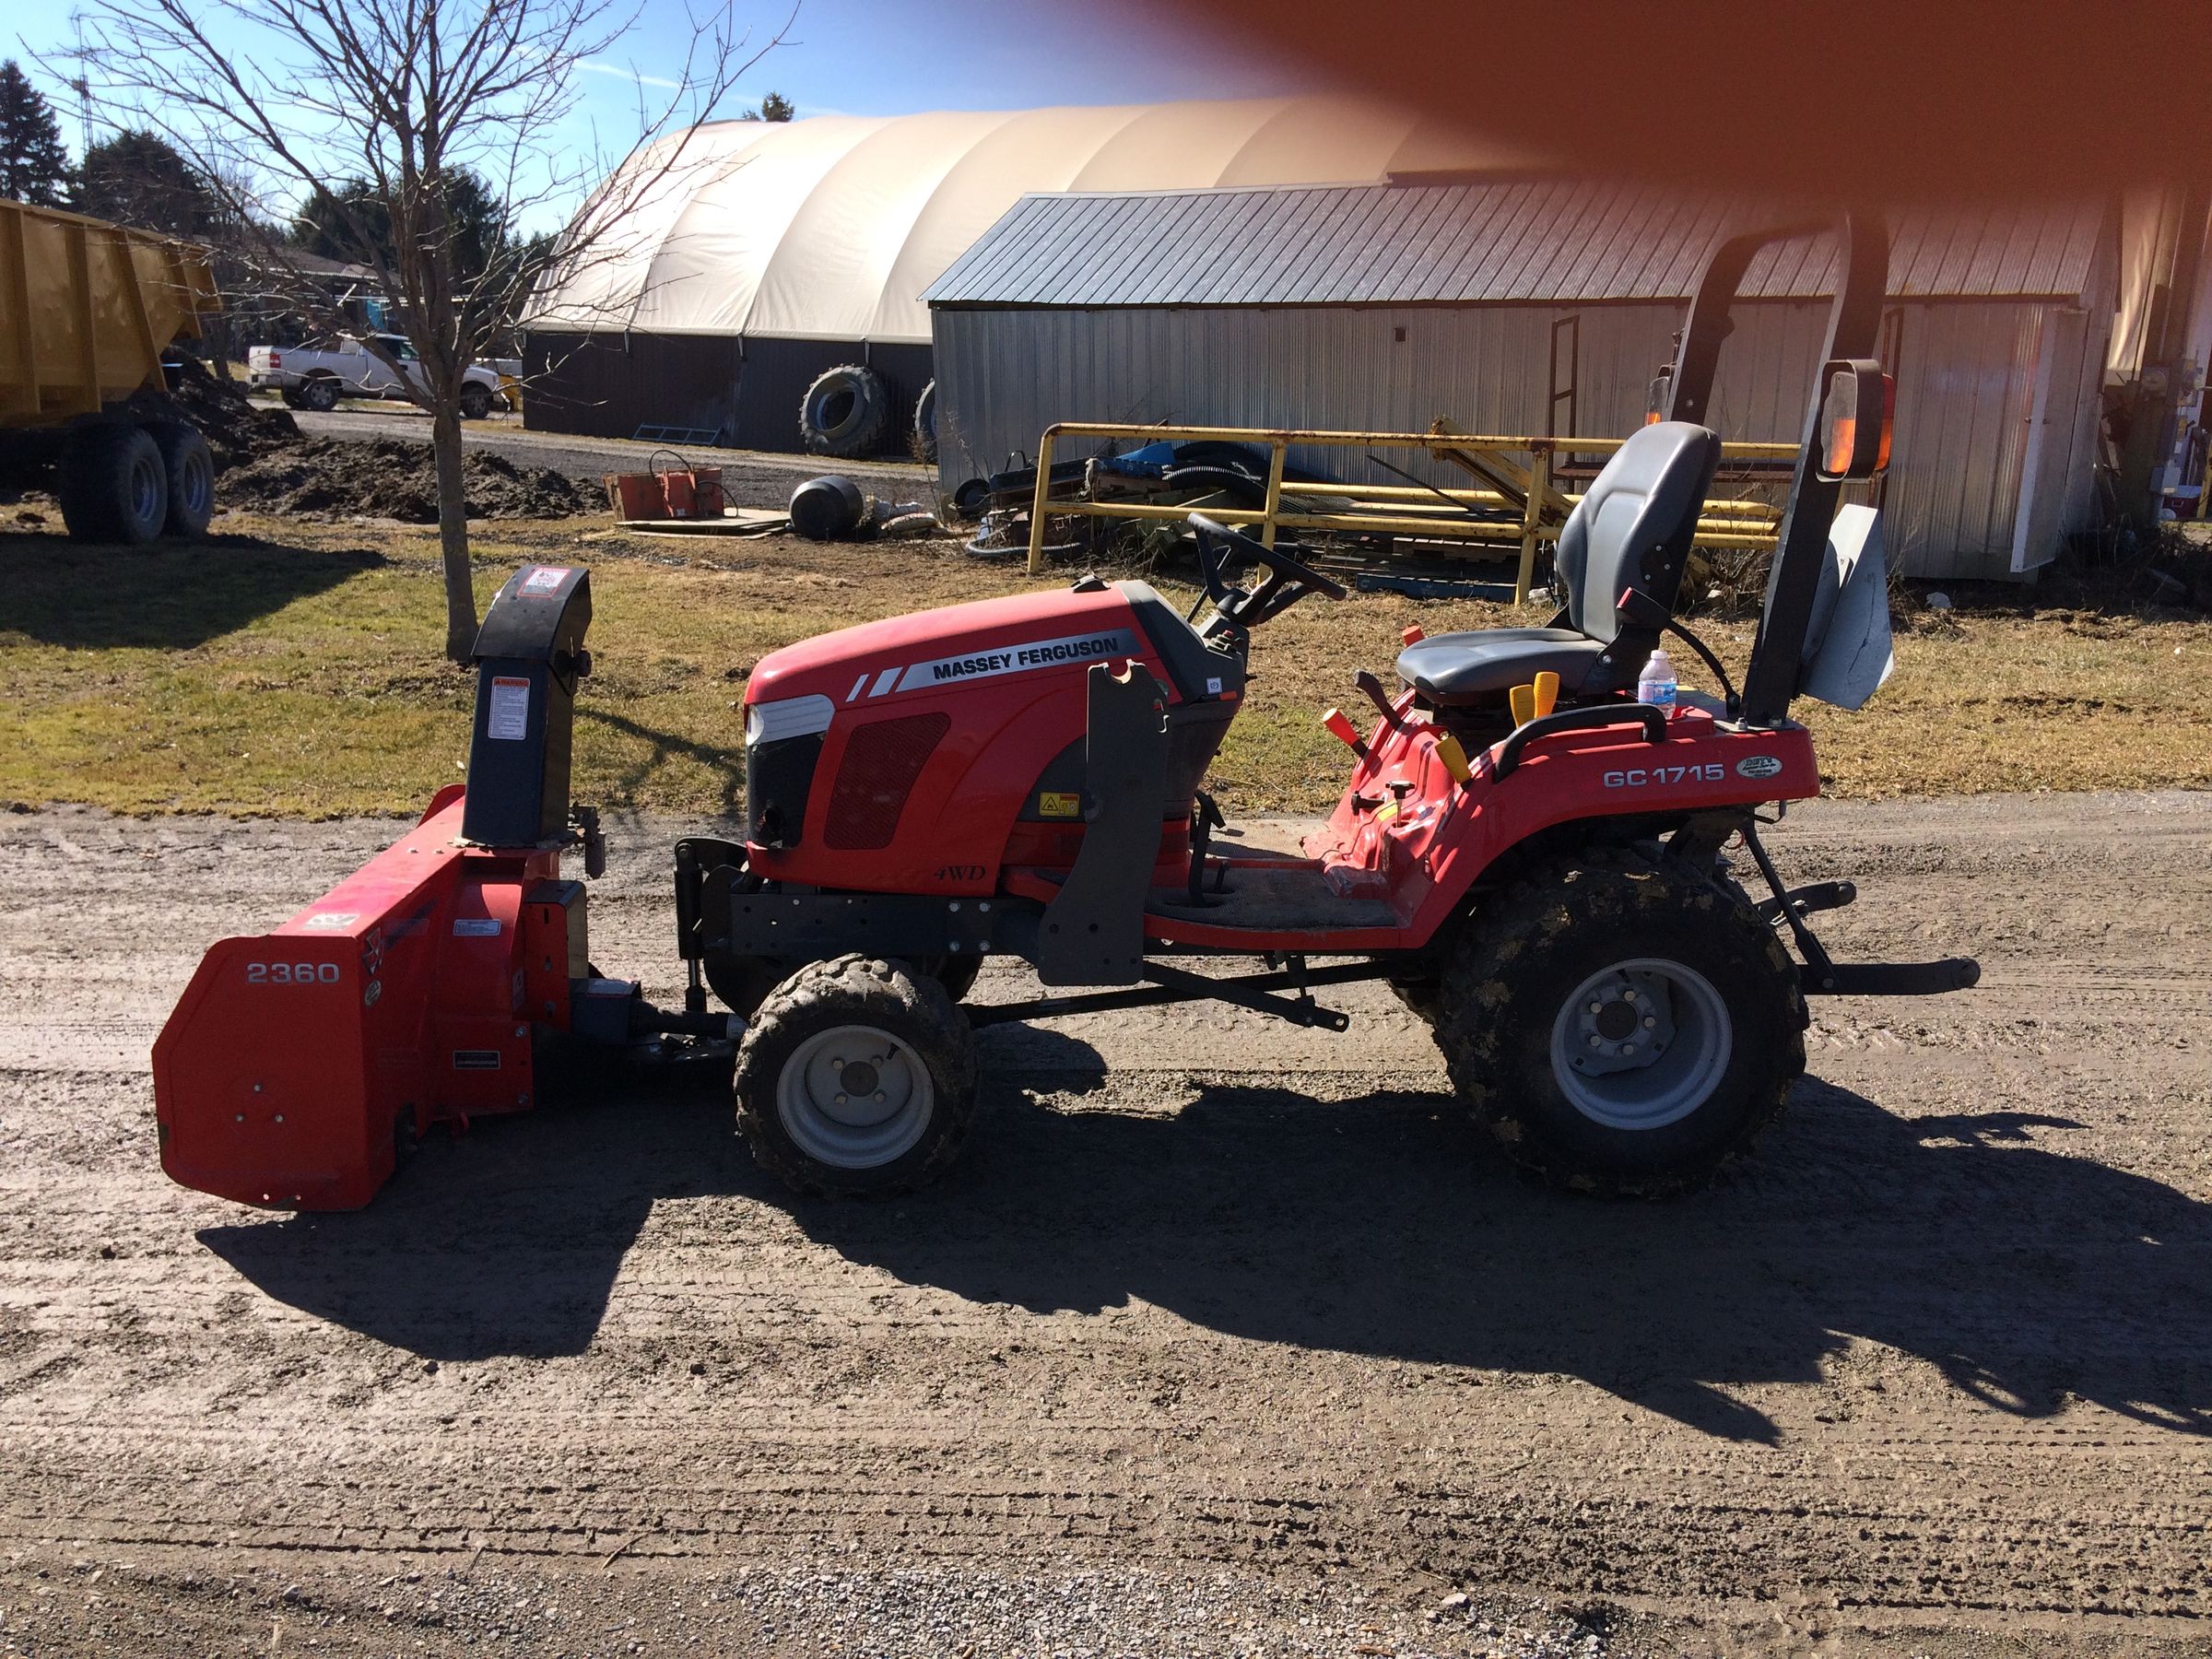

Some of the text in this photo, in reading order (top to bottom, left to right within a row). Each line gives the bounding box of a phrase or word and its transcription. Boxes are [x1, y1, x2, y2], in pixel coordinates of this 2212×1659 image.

[933, 638, 1119, 680] MASSEY FERGUSON
[933, 865, 986, 881] 4WD
[246, 962, 340, 983] 2360
